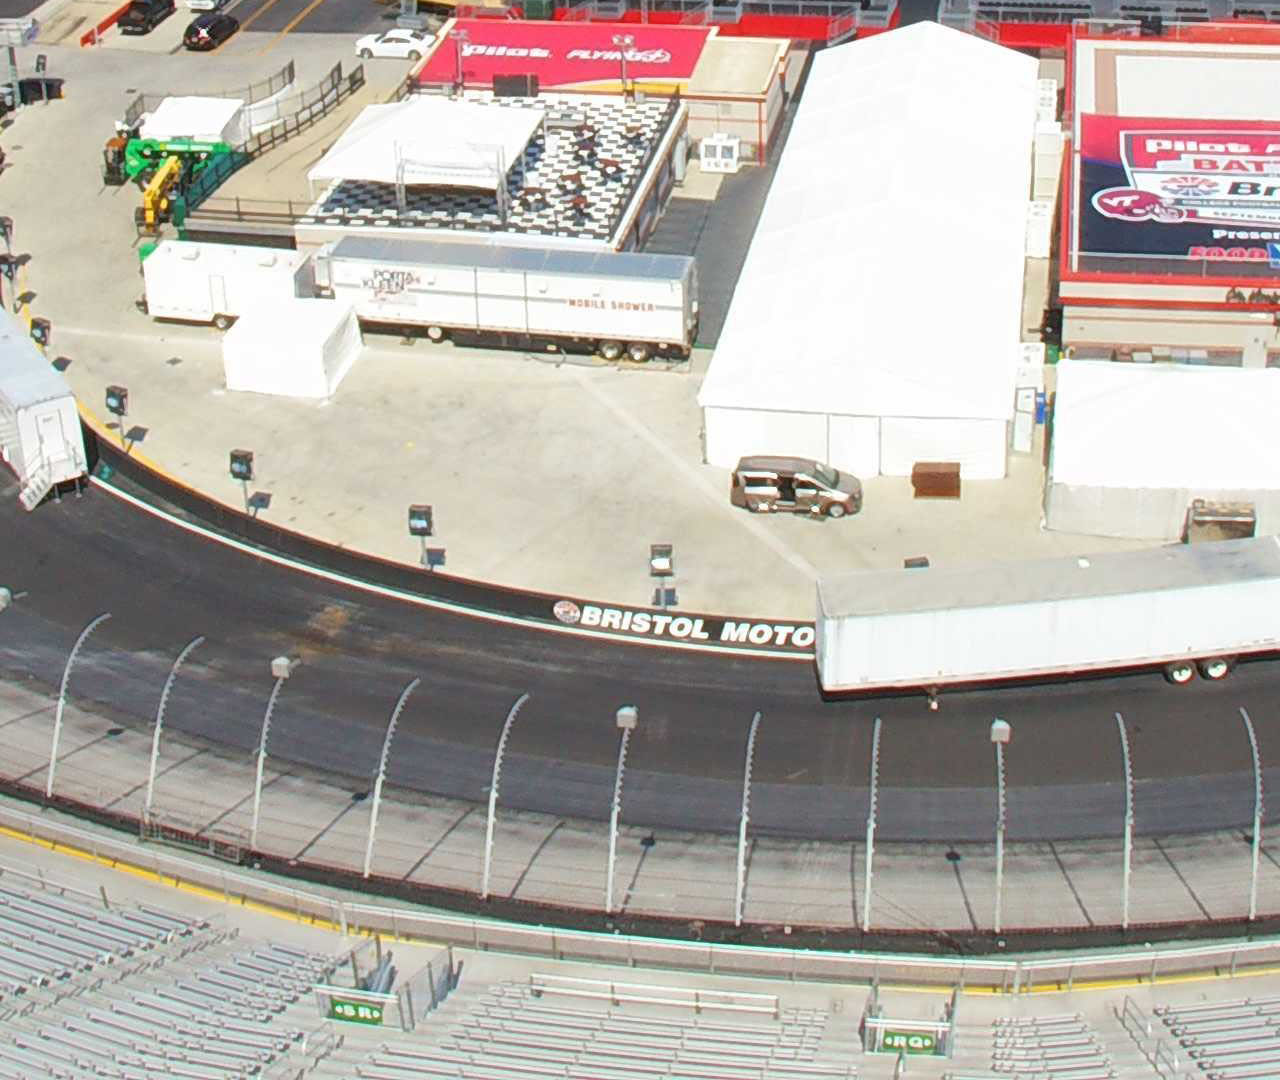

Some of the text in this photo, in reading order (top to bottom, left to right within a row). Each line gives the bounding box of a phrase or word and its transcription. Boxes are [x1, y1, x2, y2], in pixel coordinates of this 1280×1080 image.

[1187, 246, 1269, 261] FOOD
[568, 298, 656, 312] MOBILE SHOWER
[579, 605, 709, 640] BRISTOL
